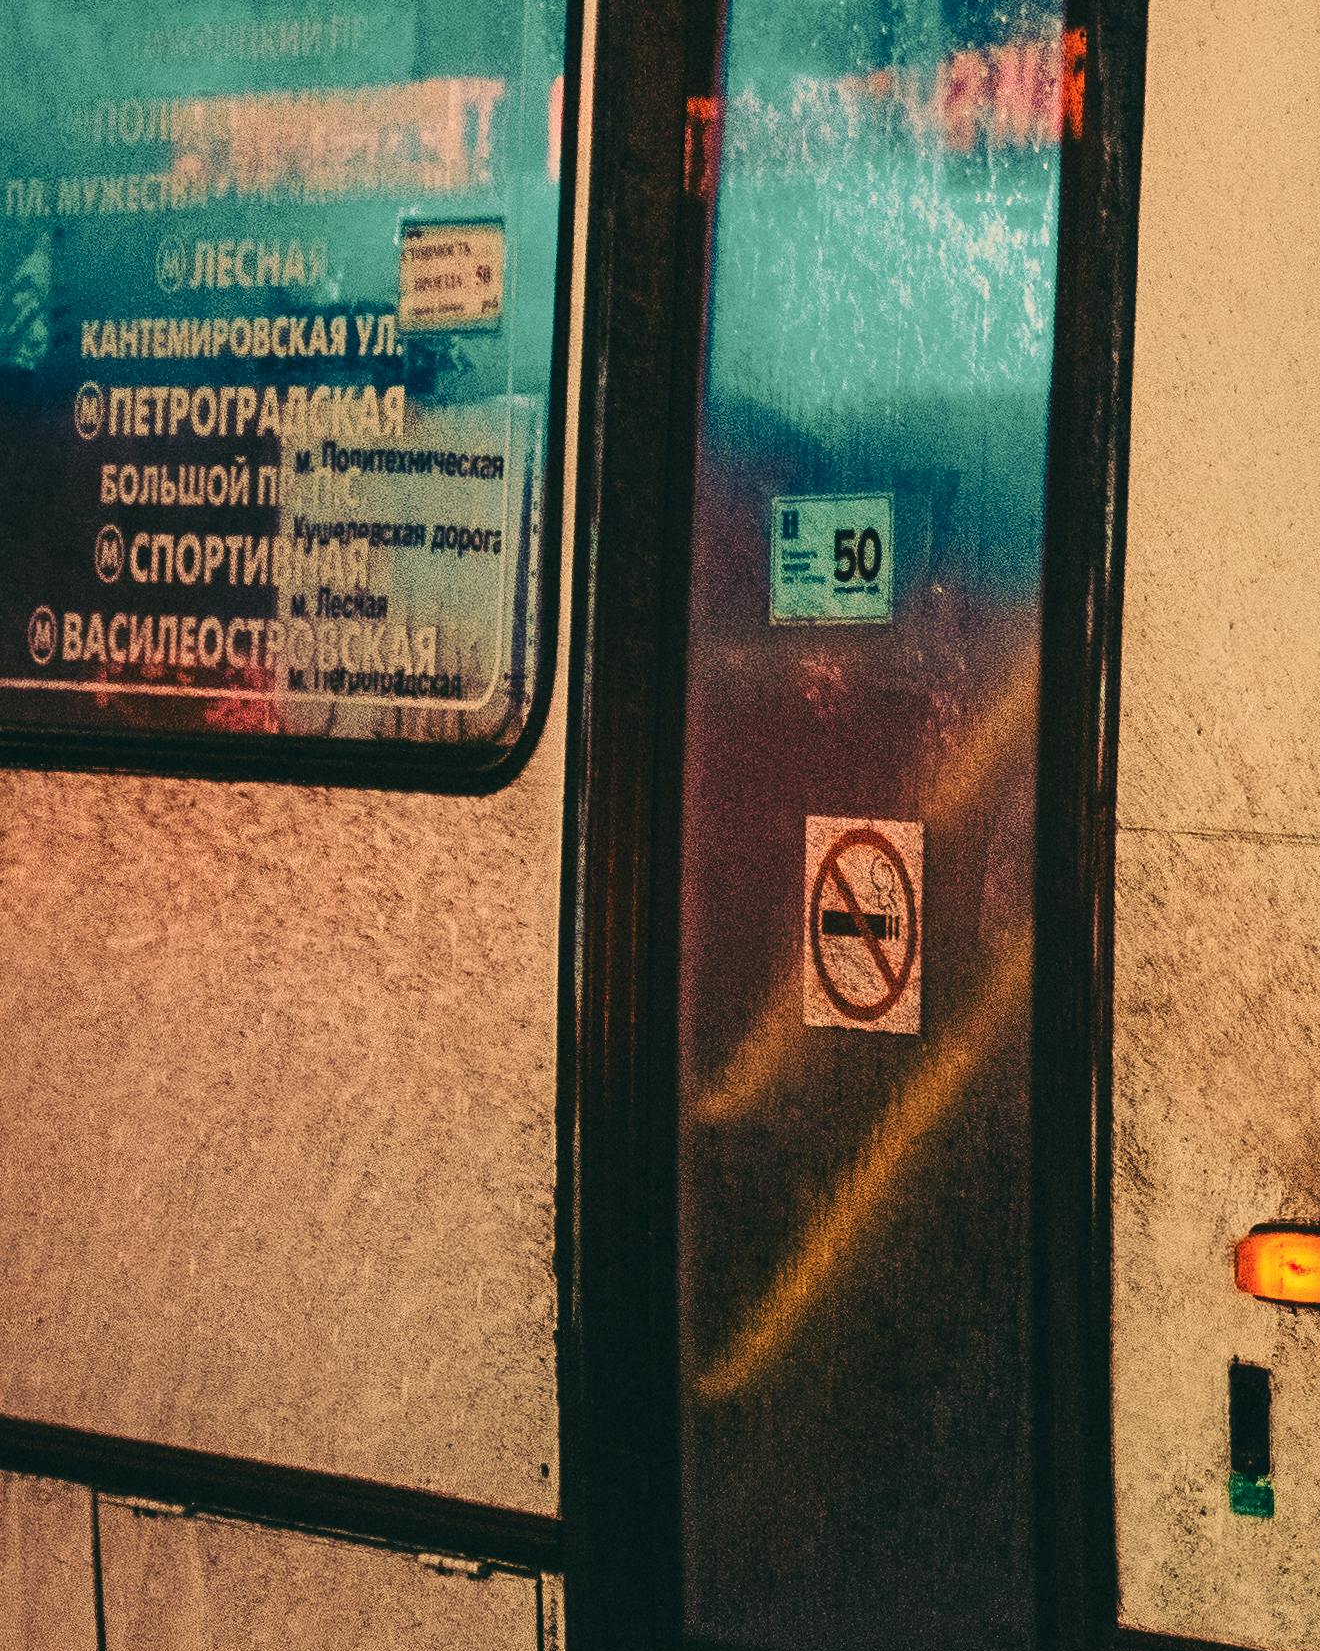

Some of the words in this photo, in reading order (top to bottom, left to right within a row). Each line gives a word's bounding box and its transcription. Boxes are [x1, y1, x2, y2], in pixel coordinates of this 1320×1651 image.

[188, 237, 328, 289] ЛЕСНАЯ
[81, 315, 347, 359] КАНТЕМИРОВСКАЯ
[356, 313, 404, 356] УЛ.
[107, 385, 406, 438] ПЕТРОГРАДСКАЯ
[101, 457, 249, 507] БОЛЬШОЙ
[322, 439, 504, 480] Политехническая
[130, 533, 369, 588] СПОРТИВНАЯ
[431, 524, 502, 557] дорога
[833, 526, 882, 582] 50
[316, 586, 388, 619] Лесная
[61, 613, 438, 676] ВАСИЛЕОСТРОВСКАЯ
